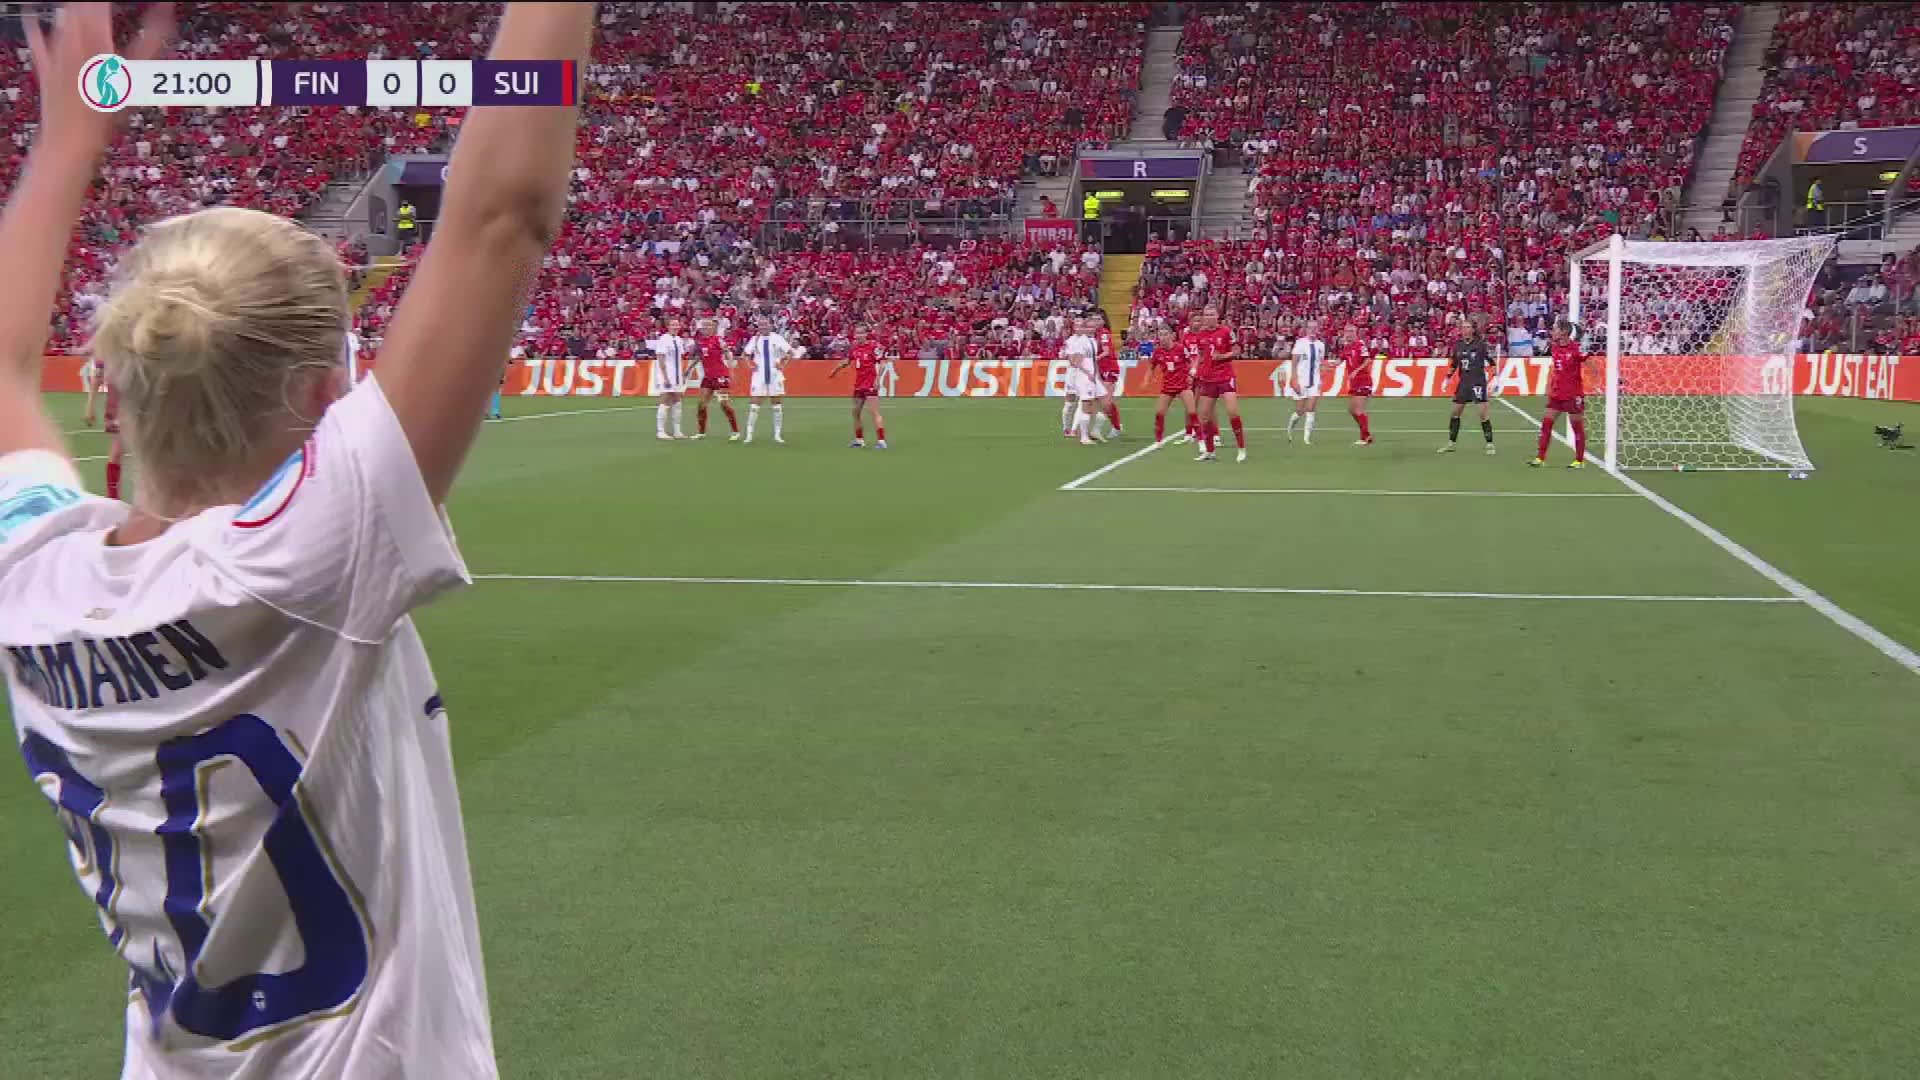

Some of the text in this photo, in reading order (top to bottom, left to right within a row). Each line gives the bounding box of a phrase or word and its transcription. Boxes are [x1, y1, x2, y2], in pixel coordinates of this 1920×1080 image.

[1852, 137, 1868, 155] S
[1133, 161, 1147, 177] R
[520, 359, 636, 395] JUST
[914, 359, 1138, 397] JUST ET
[1804, 355, 1900, 400] JUST EAT
